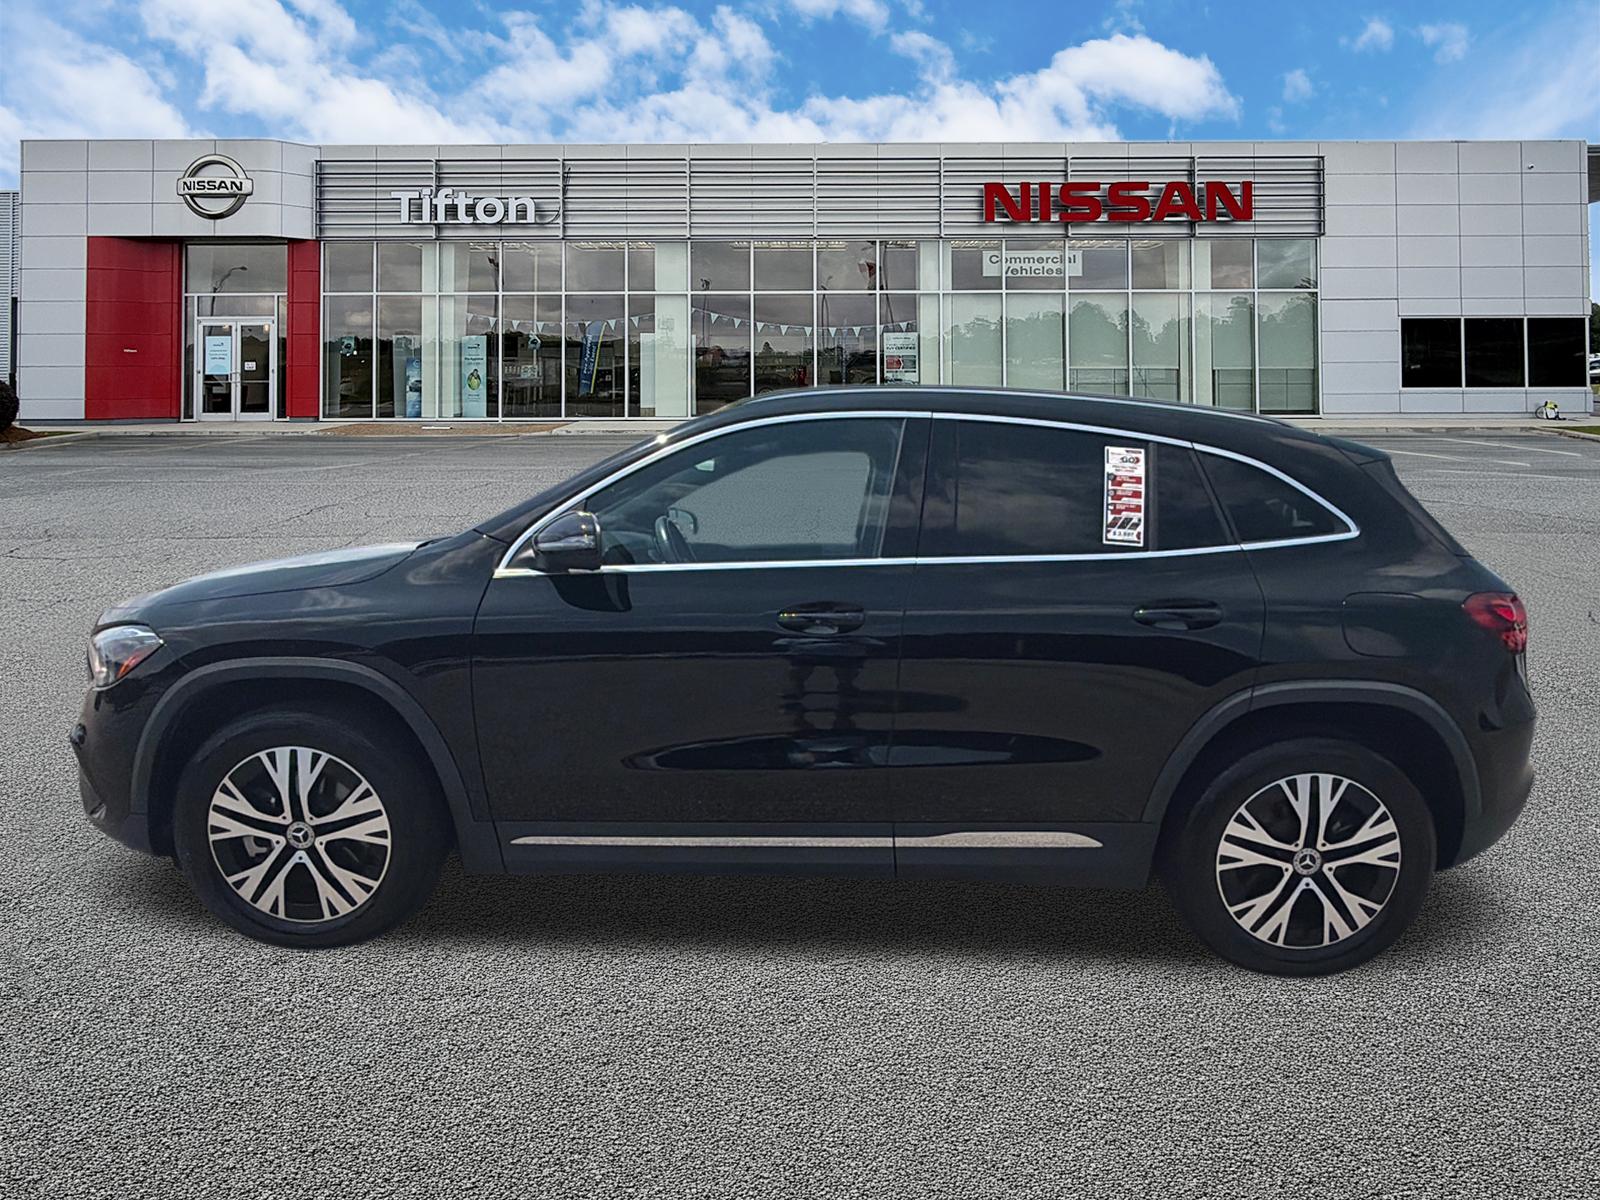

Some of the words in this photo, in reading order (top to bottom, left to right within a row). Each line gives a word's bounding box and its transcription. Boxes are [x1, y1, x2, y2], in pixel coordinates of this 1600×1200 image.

[182, 180, 243, 192] NISSAN
[983, 181, 1254, 223] NISSAN
[391, 187, 536, 225] Tifton
